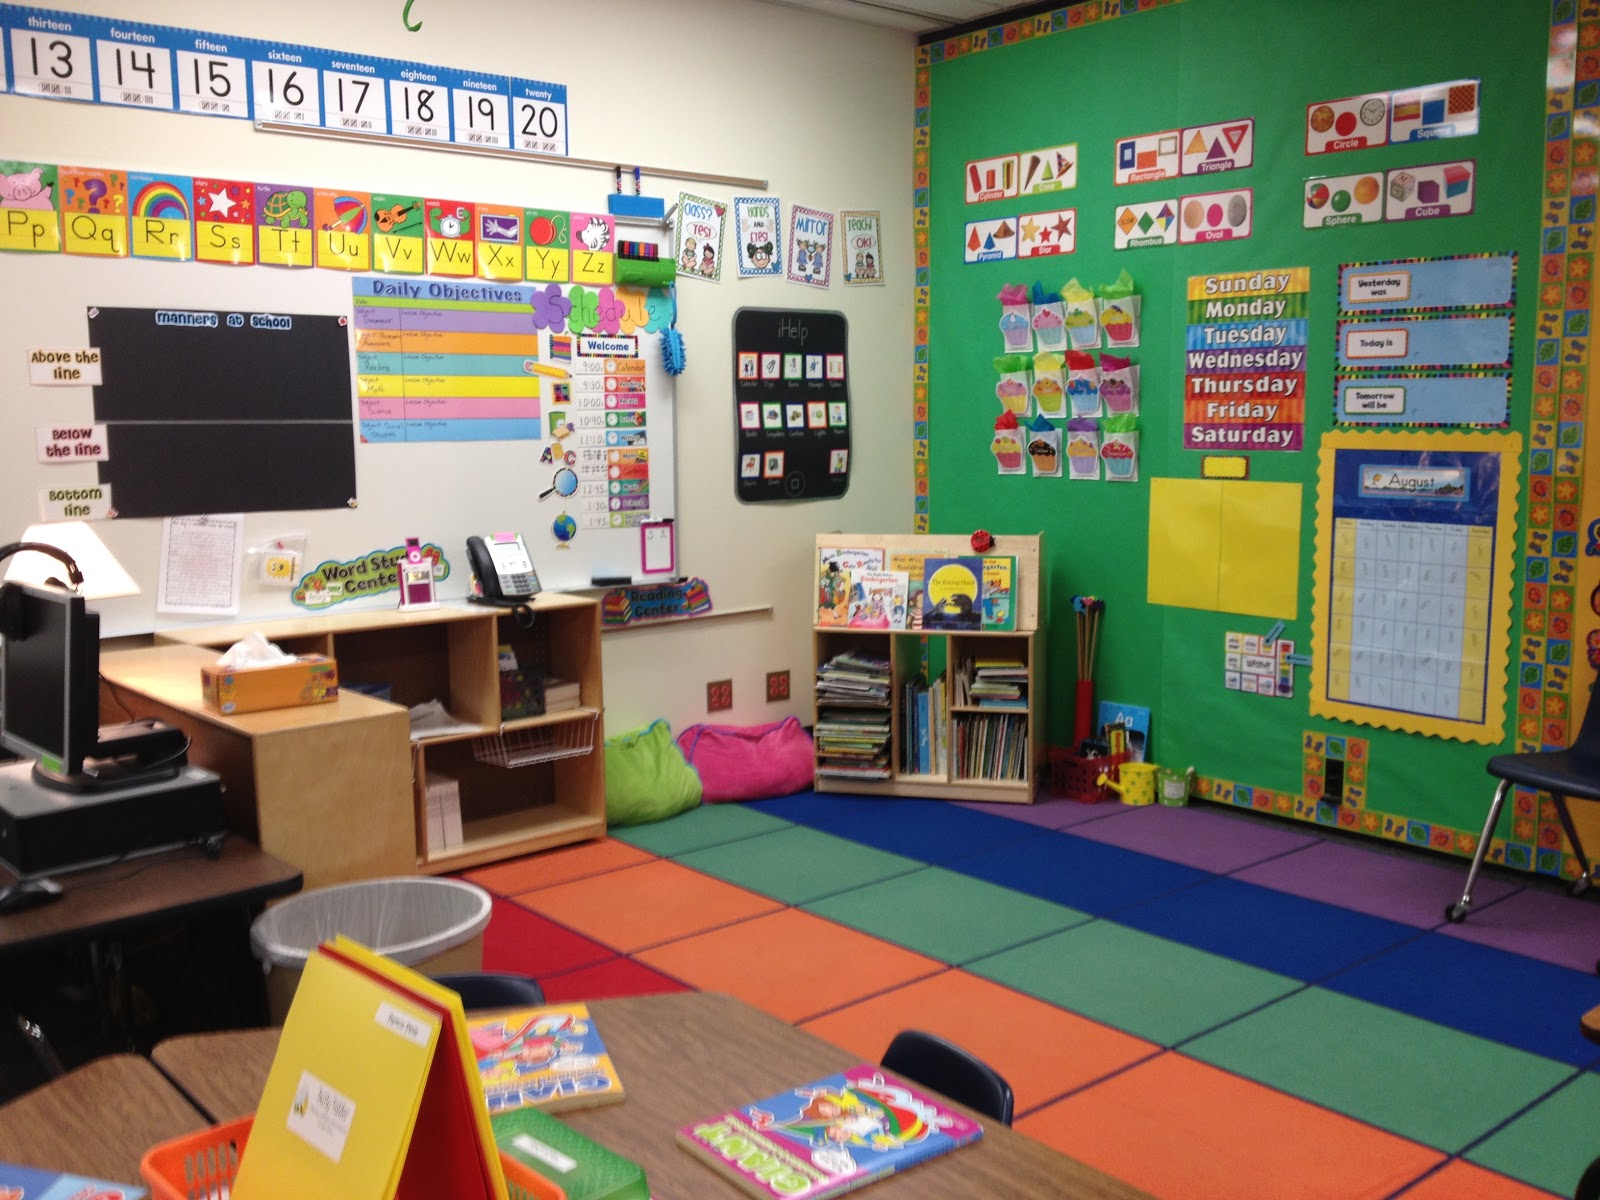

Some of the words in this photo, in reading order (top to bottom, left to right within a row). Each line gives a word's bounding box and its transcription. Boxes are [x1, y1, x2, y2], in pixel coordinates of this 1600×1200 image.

[27, 16, 72, 32] thirteen
[109, 27, 155, 43] fourteen
[194, 39, 228, 53] fifteen
[31, 37, 73, 78] 13
[268, 50, 302, 63] sixteen
[116, 48, 155, 89] 14
[331, 60, 375, 73] seventeen
[194, 58, 231, 97] 15
[400, 69, 437, 82] eighteen
[268, 68, 304, 106] 16
[463, 79, 497, 91] nineteen
[338, 78, 370, 113] 17
[525, 87, 551, 101] twenty
[405, 87, 435, 122] 18
[468, 96, 494, 130] 19
[521, 104, 558, 138] 20
[1417, 127, 1450, 139] Square
[1333, 139, 1359, 149] Circle
[1201, 161, 1233, 173] Triangle
[1130, 171, 1166, 183] Rectangle
[979, 191, 1003, 200] Cylinder
[1415, 206, 1440, 217] Cube
[1325, 215, 1357, 226] Sphere
[7, 211, 45, 248] Pp
[71, 215, 120, 253] Qq
[145, 220, 180, 244] Rr
[210, 225, 241, 249] Ss
[1205, 230, 1223, 240] Oval
[271, 228, 300, 252] Tt
[328, 233, 358, 257] Uu
[1130, 238, 1163, 248] Rhombus
[385, 237, 413, 261] Vv
[429, 241, 472, 263] Ww
[488, 245, 514, 268] Xx
[978, 252, 1002, 262] Pyramid
[1038, 246, 1053, 255] Star
[535, 249, 560, 278] Yy
[582, 251, 605, 274] Zz
[372, 280, 422, 299] Daily
[428, 283, 523, 302] Objectives
[1205, 272, 1290, 294] Sunday
[1358, 278, 1401, 289] Yesterday
[1370, 288, 1387, 296] was
[548, 293, 661, 325] Schedule
[1205, 299, 1286, 319] Monday
[157, 313, 216, 326] manners
[228, 315, 243, 326] at
[252, 316, 291, 328] school
[778, 318, 808, 346] iHelp
[1204, 324, 1287, 346] Tuesday
[588, 341, 629, 351] Welcome
[1360, 339, 1384, 348] Today
[1386, 338, 1393, 347] is
[31, 352, 70, 363] Above
[75, 351, 98, 363] the
[1188, 349, 1302, 370] Wednesday
[53, 367, 81, 380] line
[1191, 375, 1297, 396] Thursday
[1355, 392, 1395, 401] Tomorrow
[1207, 400, 1278, 421] Friday
[1361, 401, 1375, 409] will
[1376, 401, 1387, 409] be
[52, 428, 93, 440] Below
[1191, 426, 1294, 447] Saturday
[46, 445, 71, 457] the
[75, 443, 101, 456] line
[564, 450, 577, 466] C
[1389, 473, 1435, 493] August
[49, 488, 102, 501] Bottom
[64, 504, 90, 517] line
[322, 561, 366, 581] Word
[631, 589, 682, 602] Reading
[635, 604, 678, 617] Center
